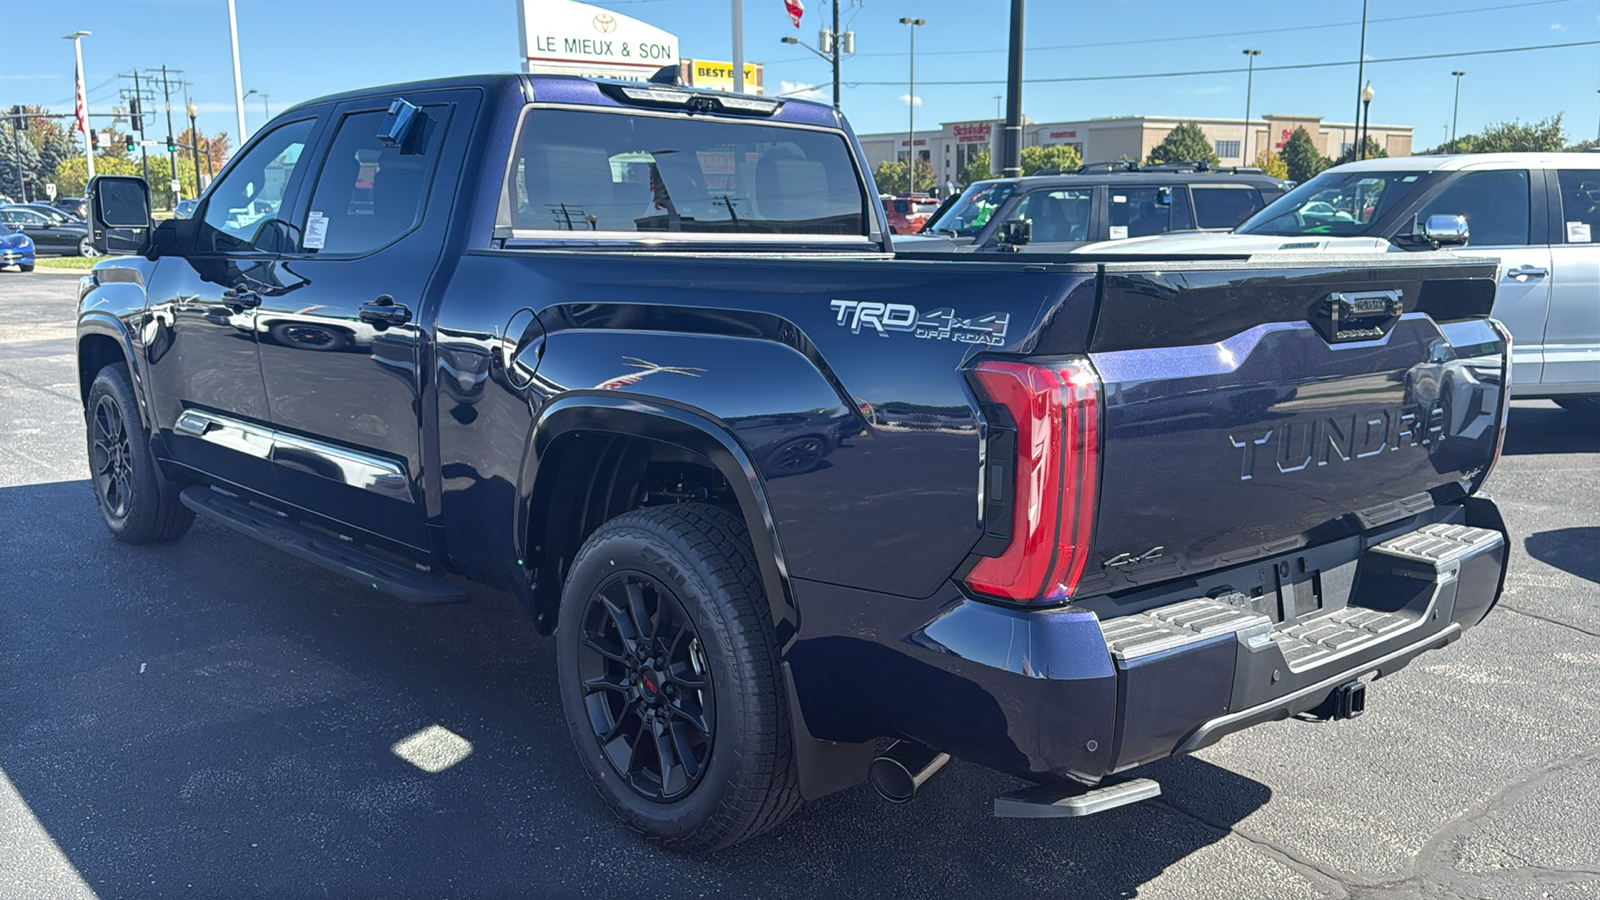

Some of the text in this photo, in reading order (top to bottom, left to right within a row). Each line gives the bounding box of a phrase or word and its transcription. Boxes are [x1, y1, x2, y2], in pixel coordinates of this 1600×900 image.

[536, 35, 671, 60] LE MIEUX & SON
[697, 67, 752, 80] BEST BY
[829, 299, 919, 338] TRD
[914, 328, 1006, 347] OFF ROAD
[1228, 403, 1446, 481] TUNDRA
[642, 674, 658, 694] TRD
